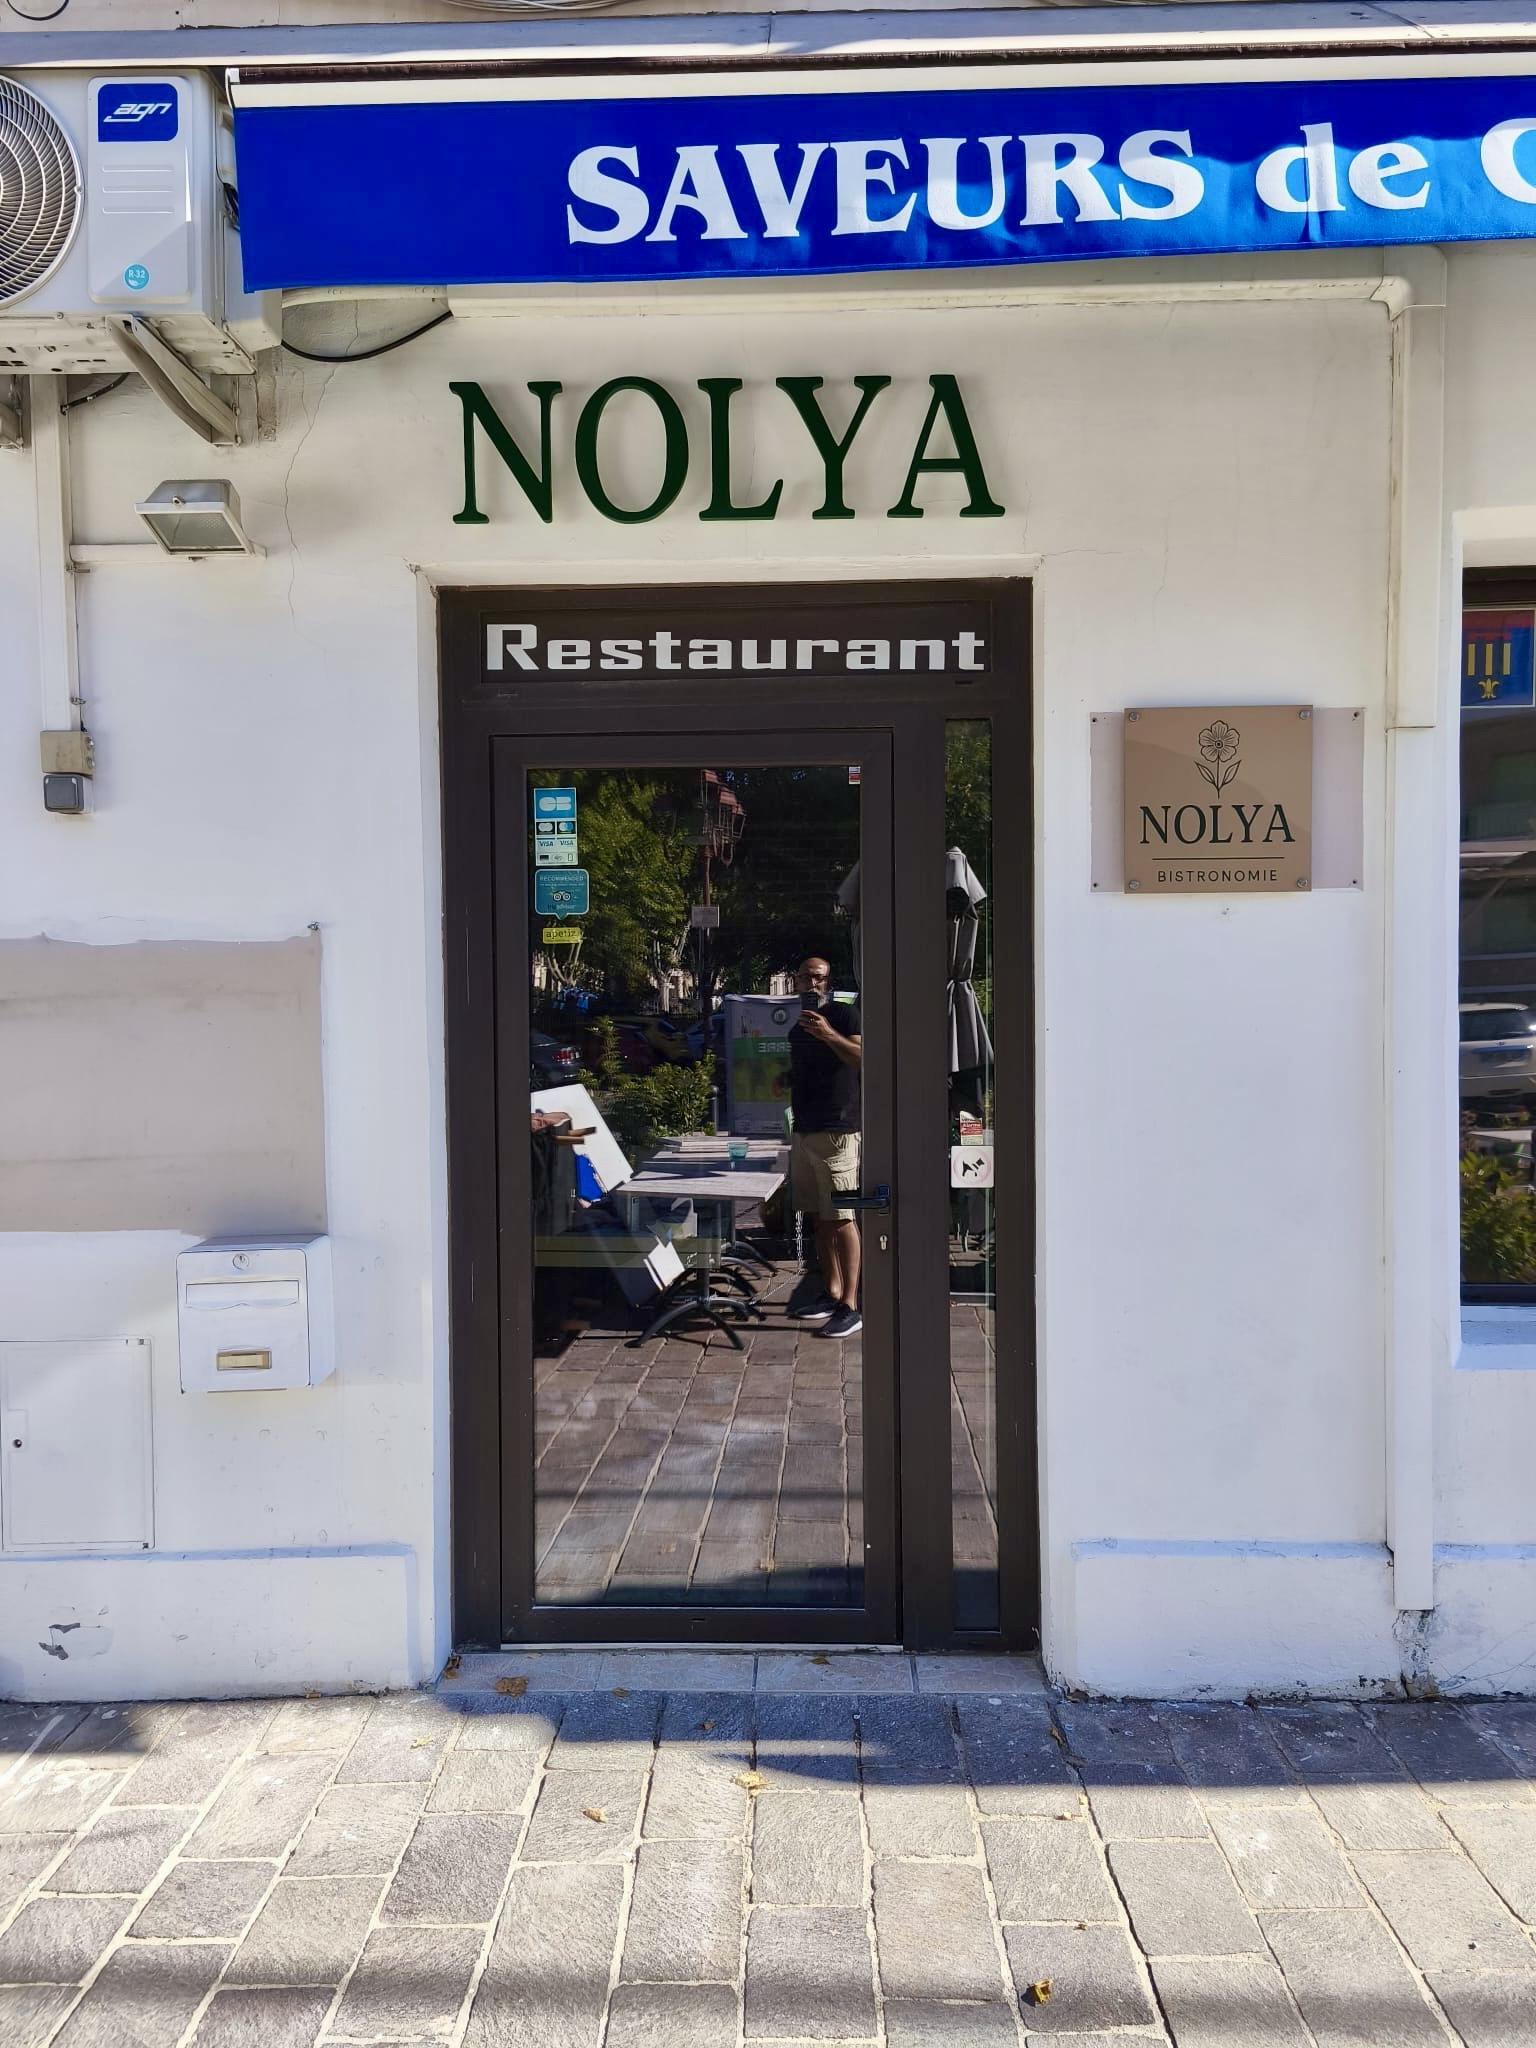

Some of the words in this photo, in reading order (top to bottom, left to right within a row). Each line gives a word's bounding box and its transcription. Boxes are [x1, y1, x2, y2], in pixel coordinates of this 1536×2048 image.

[567, 129, 1205, 244] SAVEURS
[1255, 122, 1431, 212] de
[449, 374, 1006, 524] NOLYA
[486, 623, 985, 671] Restaurant
[1140, 804, 1296, 844] NOLYA
[1157, 869, 1278, 883] BISTRONOMIE
